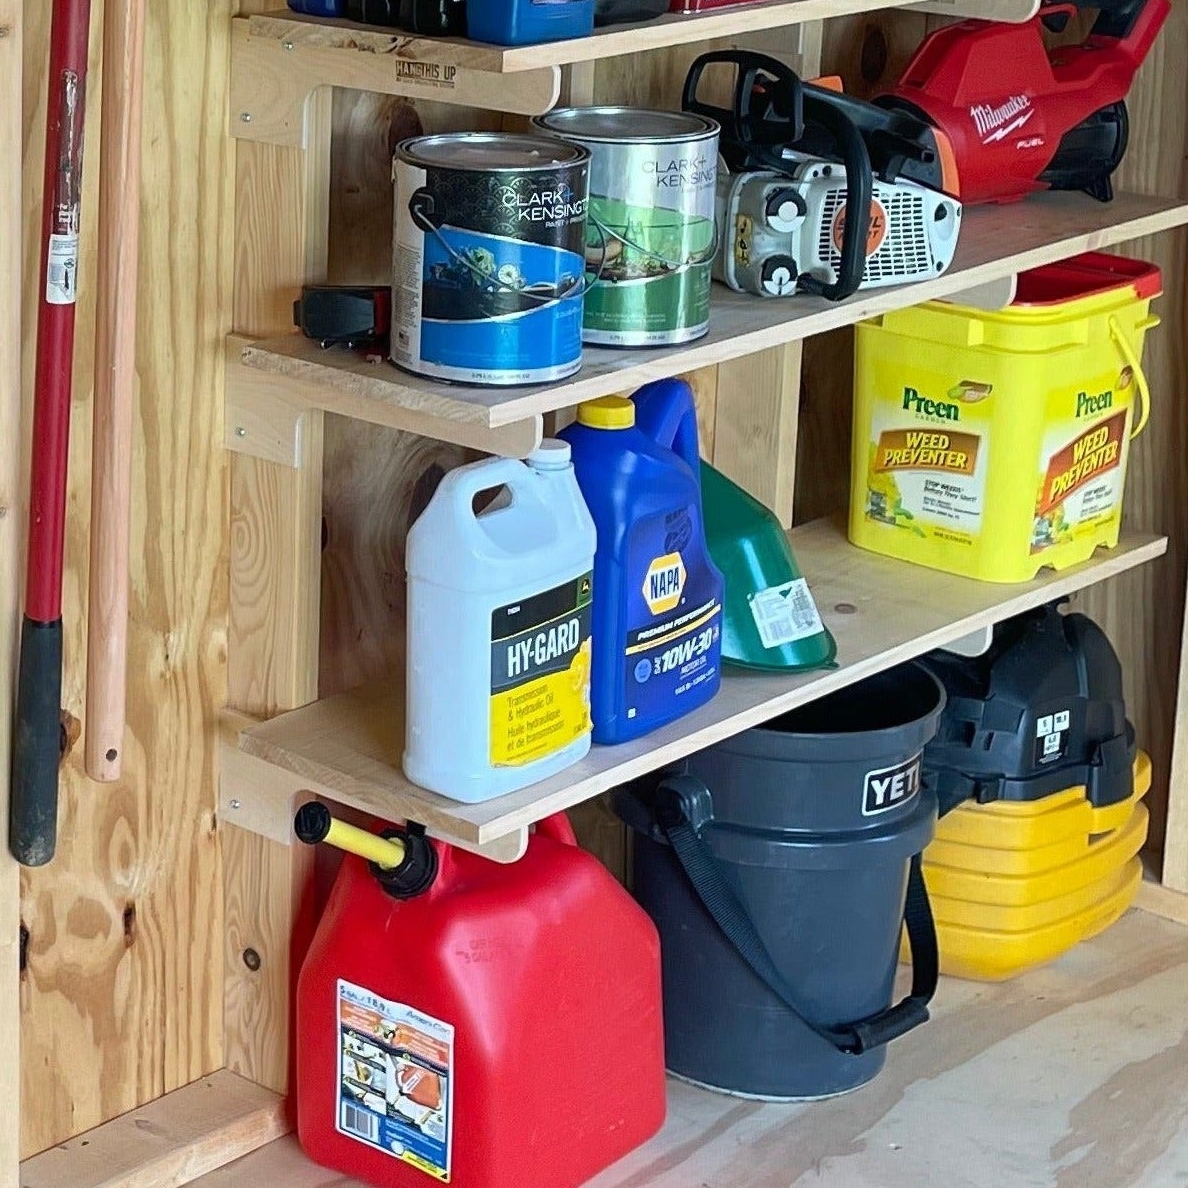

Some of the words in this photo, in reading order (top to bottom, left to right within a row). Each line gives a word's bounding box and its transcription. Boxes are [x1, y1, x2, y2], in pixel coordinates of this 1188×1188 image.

[443, 65, 456, 81] UP
[970, 94, 1031, 138] Milwaukee
[1016, 137, 1045, 150] FUEL
[902, 387, 959, 422] Preen
[1075, 390, 1112, 418] Preen
[906, 432, 950, 450] WEED
[1073, 426, 1109, 465] WEED
[884, 448, 969, 469] PREVENTER
[1050, 440, 1118, 504] PREVENTER
[650, 566, 681, 600] NAPA
[637, 621, 674, 641] PREMIUM
[673, 597, 715, 628] PERFORMANCE
[507, 617, 580, 678] HY-GARD
[661, 627, 713, 673] 10W-30
[507, 684, 548, 709] Transmission
[507, 709, 514, 722] &
[515, 699, 544, 719] Hydraulic
[545, 691, 554, 706] Oil
[507, 723, 525, 739] Huile
[526, 708, 561, 732] hydraulique
[507, 740, 515, 751] et
[516, 736, 525, 749] de
[526, 719, 565, 744] transmission
[871, 760, 920, 806] YETI
